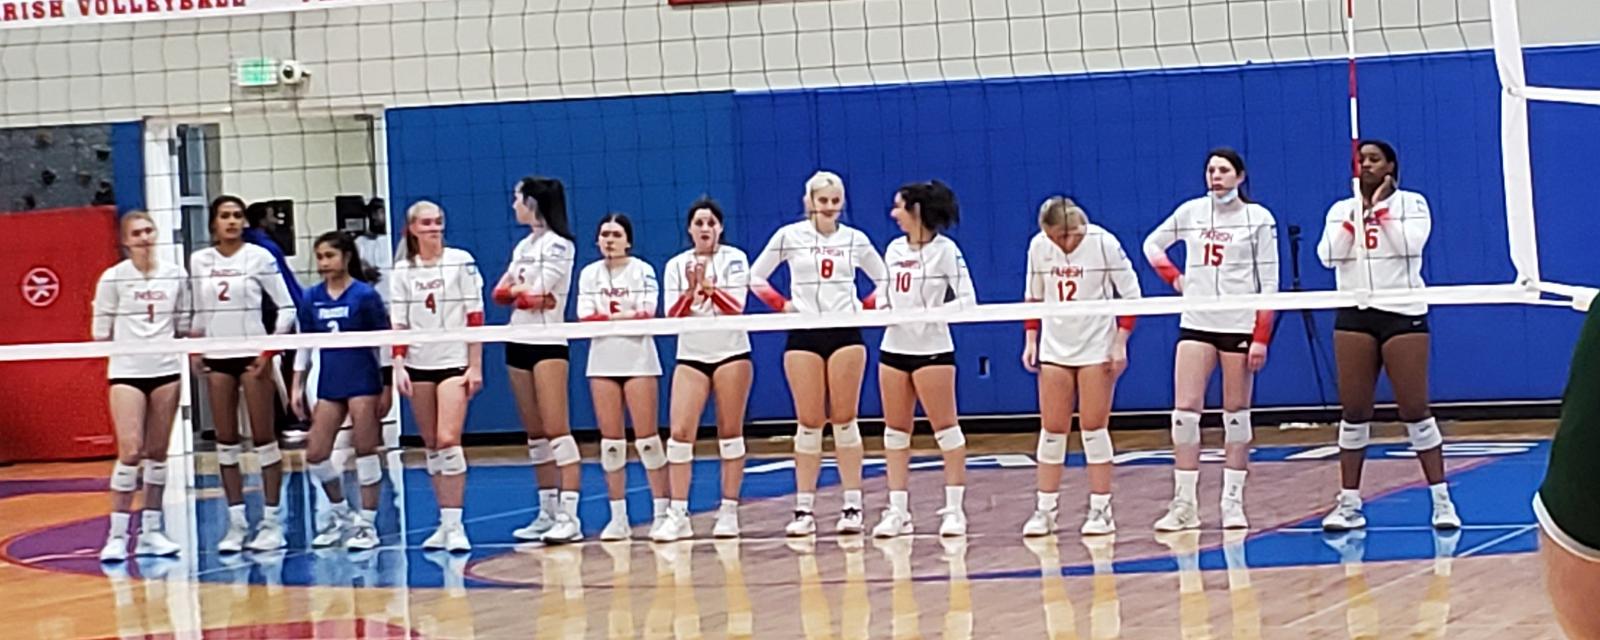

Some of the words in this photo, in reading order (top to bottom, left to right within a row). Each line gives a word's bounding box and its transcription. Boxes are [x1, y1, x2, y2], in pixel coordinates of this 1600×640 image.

[0, 1, 65, 21] RISH
[1203, 243, 1224, 267] 15
[821, 259, 833, 279] 8
[218, 281, 230, 301] 2
[896, 271, 911, 292] 10
[1057, 280, 1078, 301] 12
[147, 303, 154, 323] 1
[425, 293, 436, 314] 4
